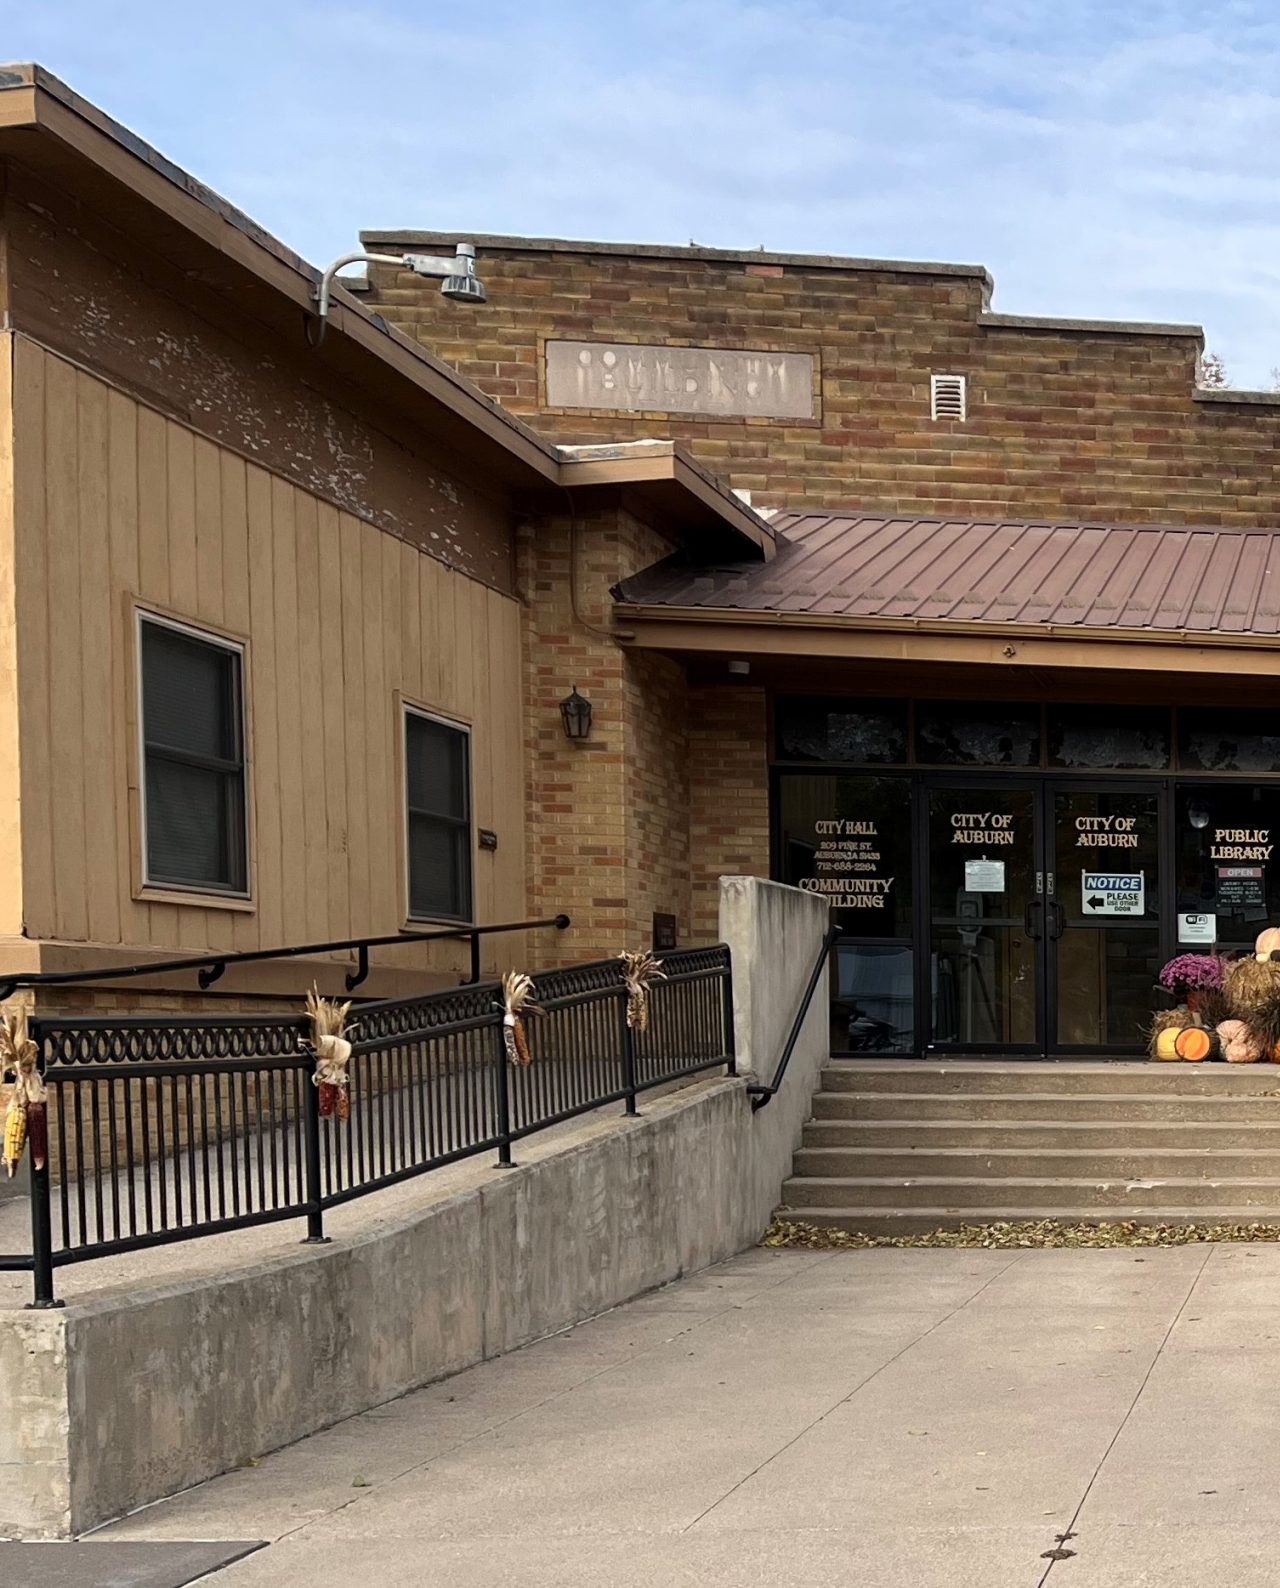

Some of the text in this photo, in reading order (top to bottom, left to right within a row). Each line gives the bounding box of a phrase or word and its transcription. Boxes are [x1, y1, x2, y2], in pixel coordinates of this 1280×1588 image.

[815, 819, 878, 835] CITY HALL
[951, 812, 1013, 828] CITY OF
[1075, 815, 1137, 831] CITY OF
[951, 830, 1015, 844] AUBURN
[1075, 833, 1139, 848] AUBURN
[1215, 829, 1270, 843] PUBLIC
[820, 841, 837, 850] 209
[1210, 845, 1274, 860] LIBRARY
[1227, 868, 1254, 877] OPEN
[798, 877, 895, 893] COMMUNITY
[1086, 877, 1140, 889] NOTICE
[827, 894, 884, 908] ILDING
[1106, 892, 1140, 901] PLEASE
